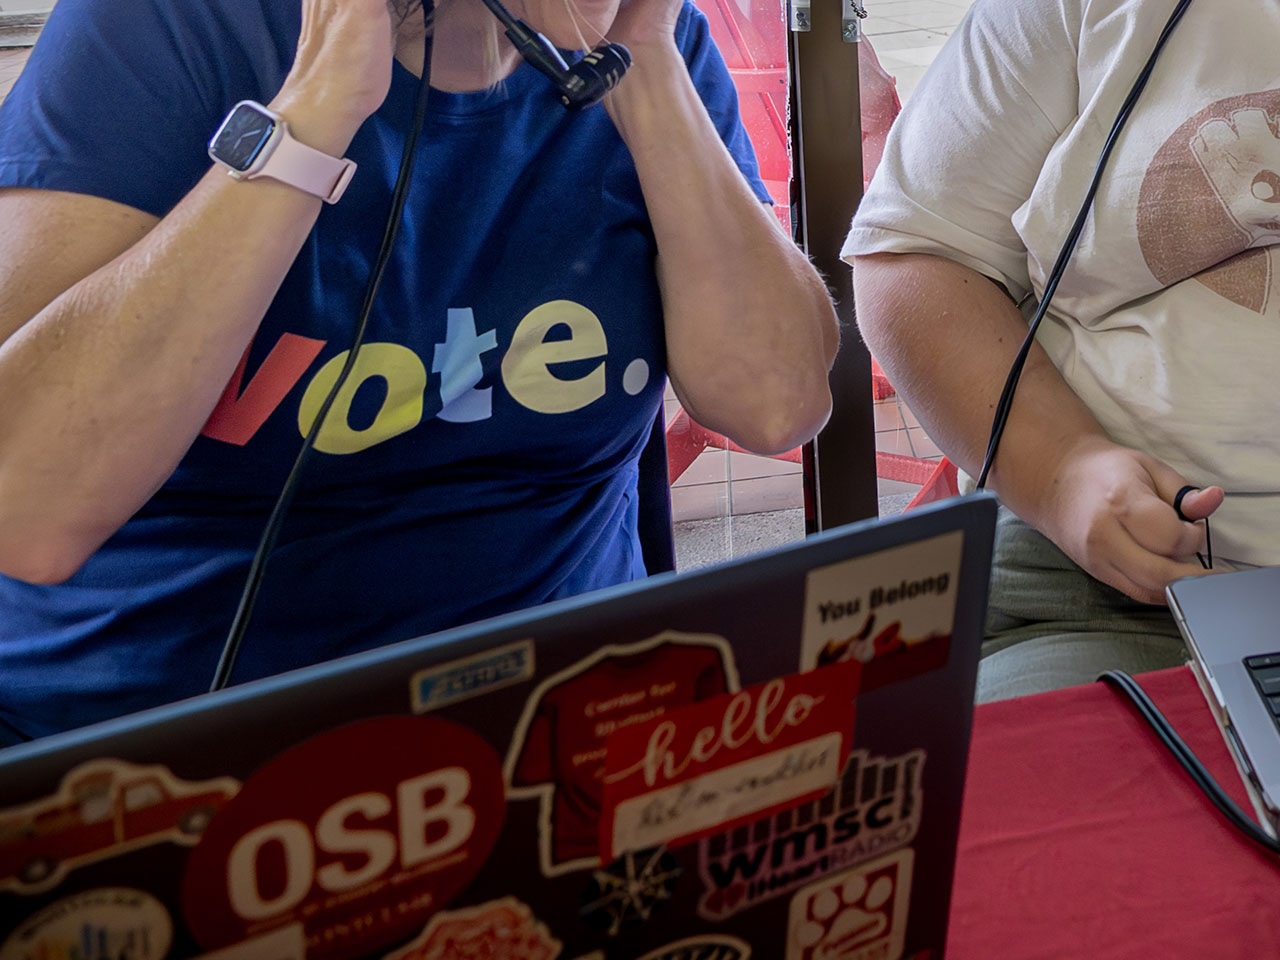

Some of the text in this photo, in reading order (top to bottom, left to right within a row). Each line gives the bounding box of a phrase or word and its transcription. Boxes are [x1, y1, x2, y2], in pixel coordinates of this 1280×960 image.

[201, 298, 650, 455] vote.
[818, 572, 951, 624] You Belong
[601, 678, 827, 788] hello
[226, 765, 477, 922] OSB
[708, 796, 894, 889] wmsc
